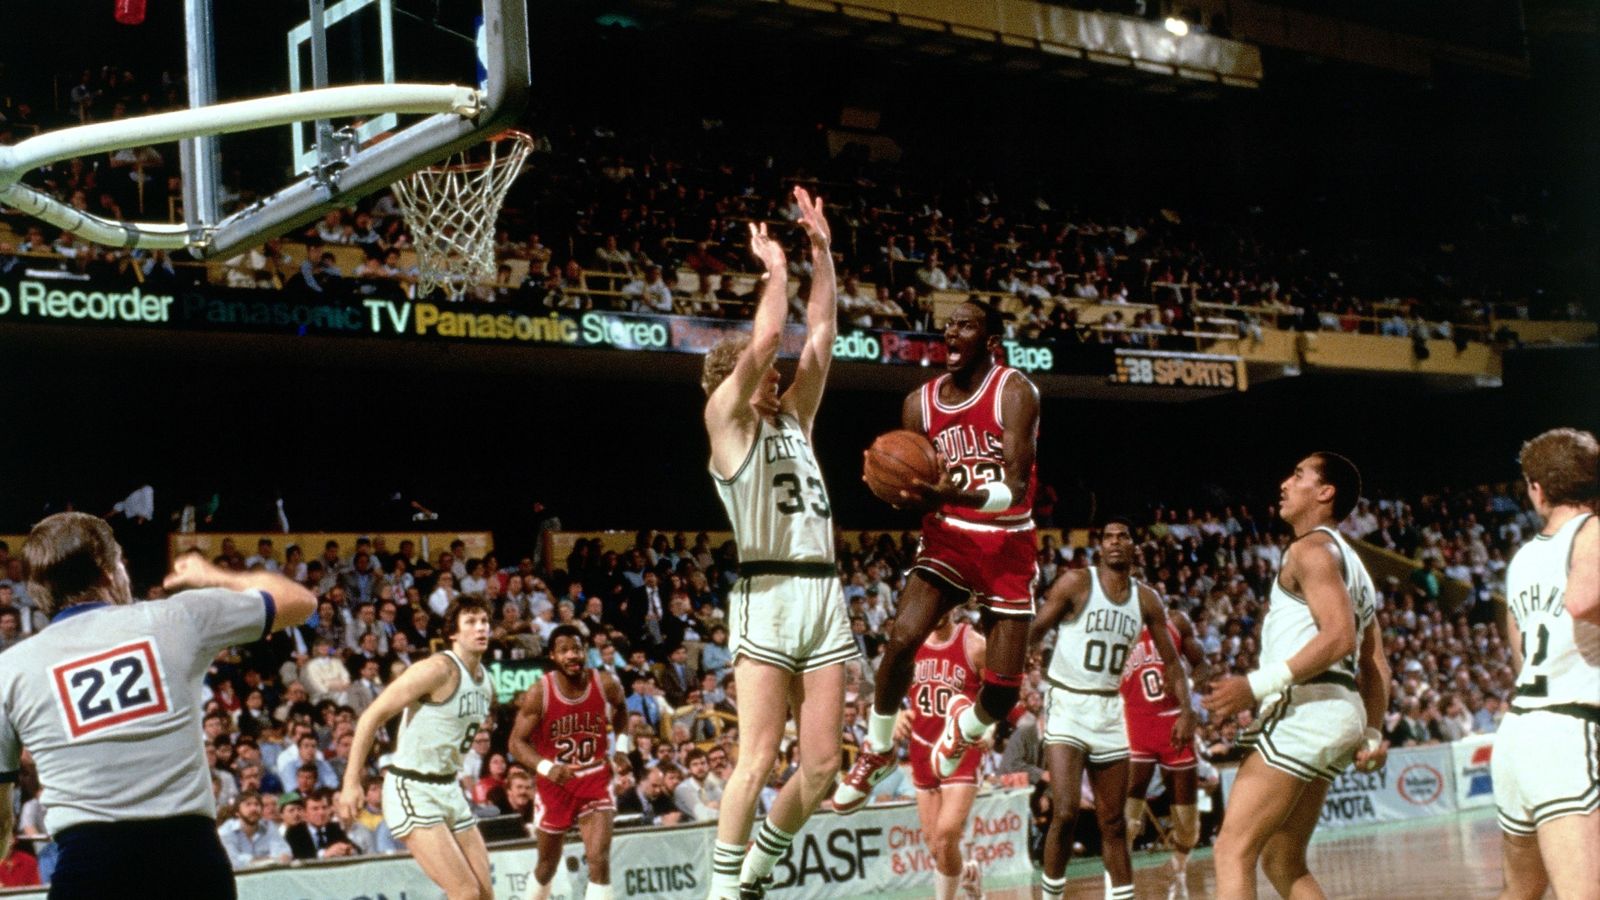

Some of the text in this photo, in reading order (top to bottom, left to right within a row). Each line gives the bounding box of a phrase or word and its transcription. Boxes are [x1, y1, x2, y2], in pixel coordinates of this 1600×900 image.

[20, 281, 173, 323] Recorder
[364, 299, 411, 333] TV
[415, 303, 578, 343] Panasonic
[582, 313, 667, 347] Stereo
[832, 330, 880, 361] adio
[1003, 341, 1053, 371] Tape
[1154, 358, 1235, 388] SPORTS
[773, 473, 831, 519] 33
[1085, 608, 1137, 641] CELTICS
[1083, 639, 1129, 675] 00
[70, 656, 152, 721] 22
[489, 662, 544, 693] lson
[915, 684, 955, 718] 40
[554, 737, 597, 766] 20
[1329, 766, 1387, 795] LESLEY
[1320, 795, 1375, 823] OYOTA
[625, 862, 697, 897] CELTICS
